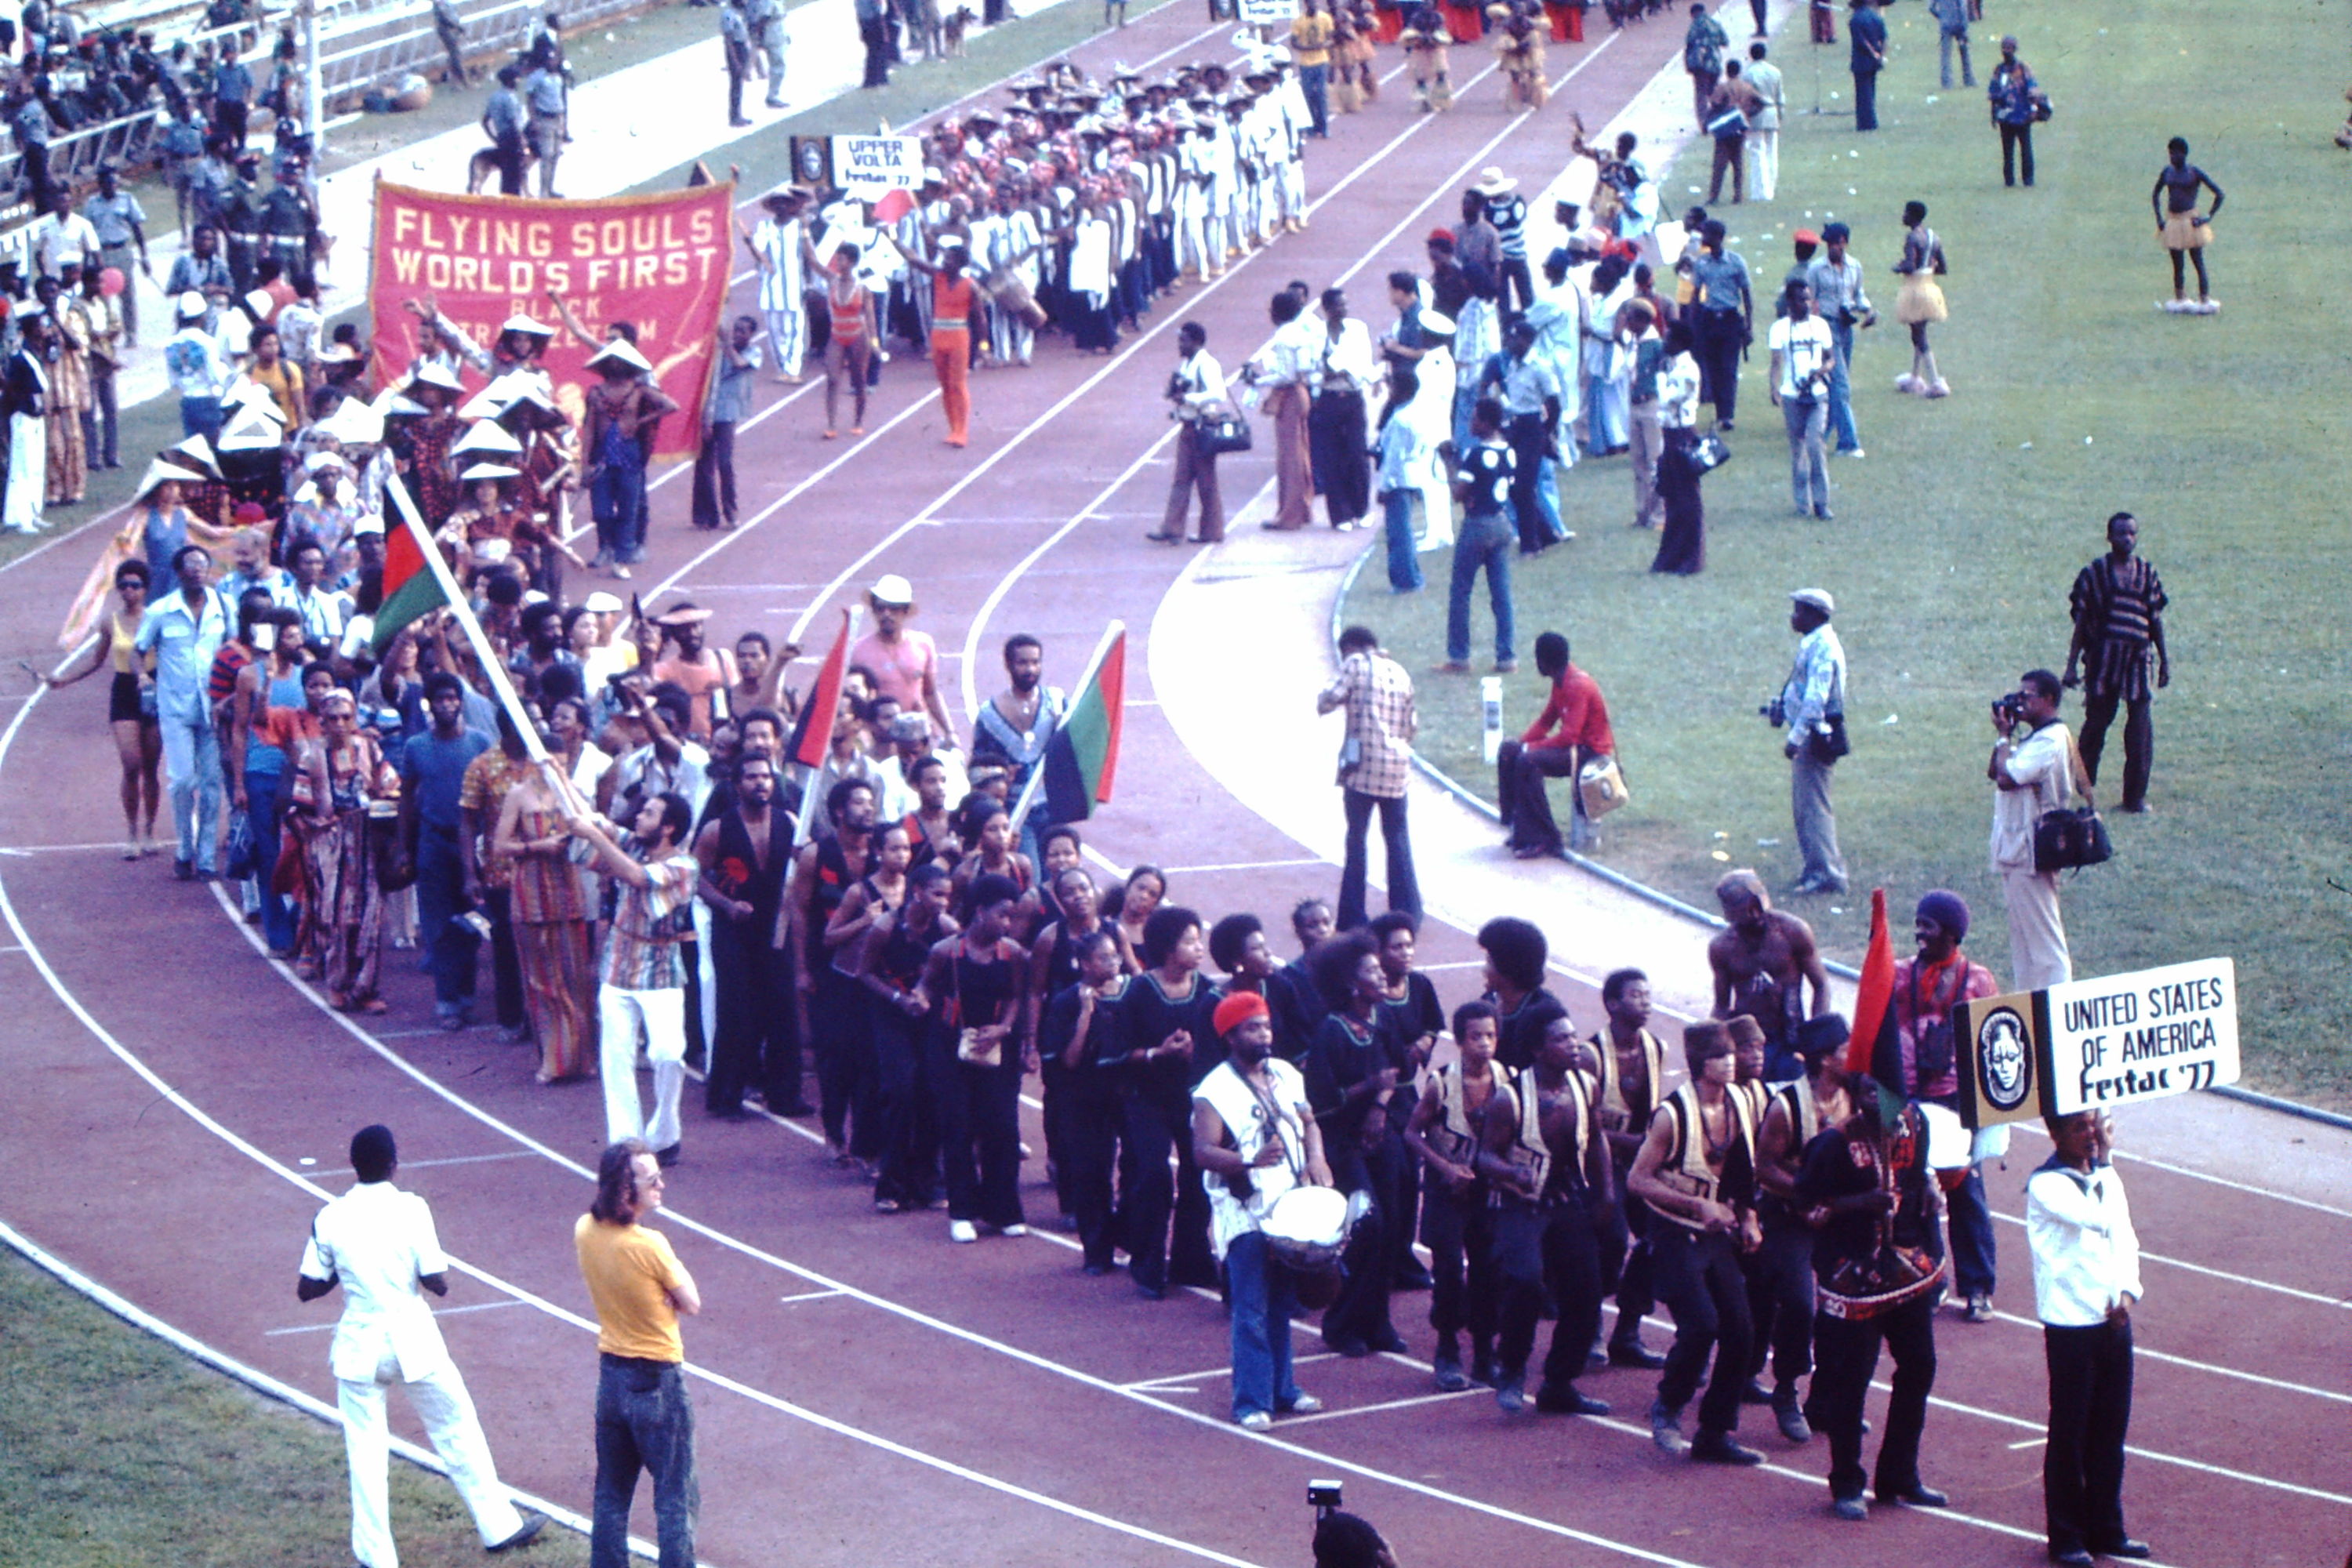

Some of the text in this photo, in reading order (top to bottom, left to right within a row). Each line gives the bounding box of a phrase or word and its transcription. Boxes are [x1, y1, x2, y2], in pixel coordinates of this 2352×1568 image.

[848, 140, 903, 153] UPPER
[852, 154, 902, 167] VOLTA
[394, 207, 714, 258] FLYING SOULS
[393, 247, 717, 294] WORLD'S FIRST
[510, 297, 602, 321] BLACK
[2063, 977, 2223, 1033] UNITED STATES
[2082, 1018, 2216, 1068] OF AMERICA
[2080, 1067, 2169, 1104] Festac
